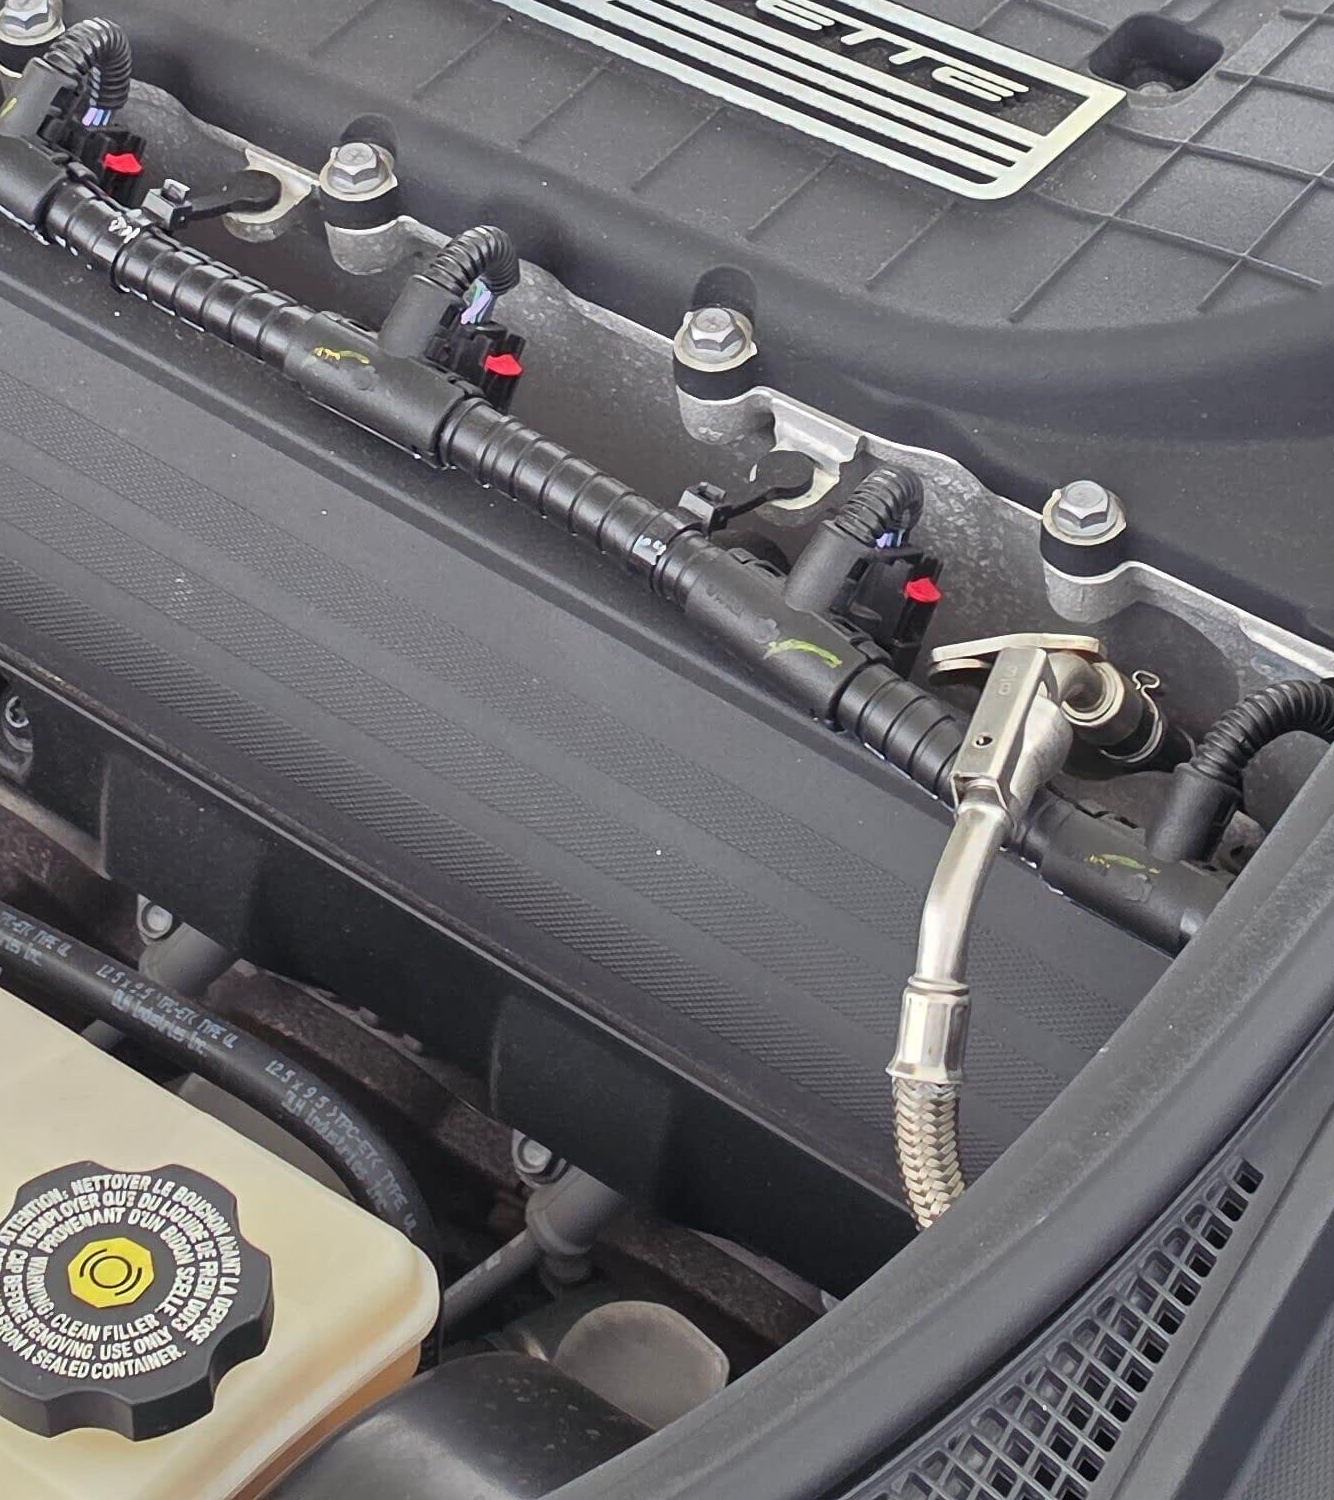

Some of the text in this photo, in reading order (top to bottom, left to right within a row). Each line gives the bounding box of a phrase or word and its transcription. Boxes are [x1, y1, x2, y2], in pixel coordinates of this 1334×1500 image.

[137, 1193, 162, 1211] DU
[37, 1207, 126, 1253] PROVENANT
[128, 1208, 166, 1232] D'UN
[160, 1225, 195, 1265] BIDON
[71, 1174, 151, 1195] NETTOYER
[172, 1186, 231, 1236] BOUCHON
[218, 1277, 240, 1295] LA
[159, 1200, 209, 1243] LIQUIDE
[6, 1249, 28, 1273] CAP
[195, 1241, 217, 1260] DE
[27, 1256, 159, 1341] WARNING: CLEAN FILLER
[194, 1261, 218, 1300] FREIN
[3, 1275, 33, 1324] BEFORE
[100, 1341, 133, 1360] USE
[133, 1325, 172, 1354] ONLY
[19, 1344, 36, 1360] A
[32, 1349, 89, 1378] SEALED
[91, 1344, 186, 1380] CONTAINER.
